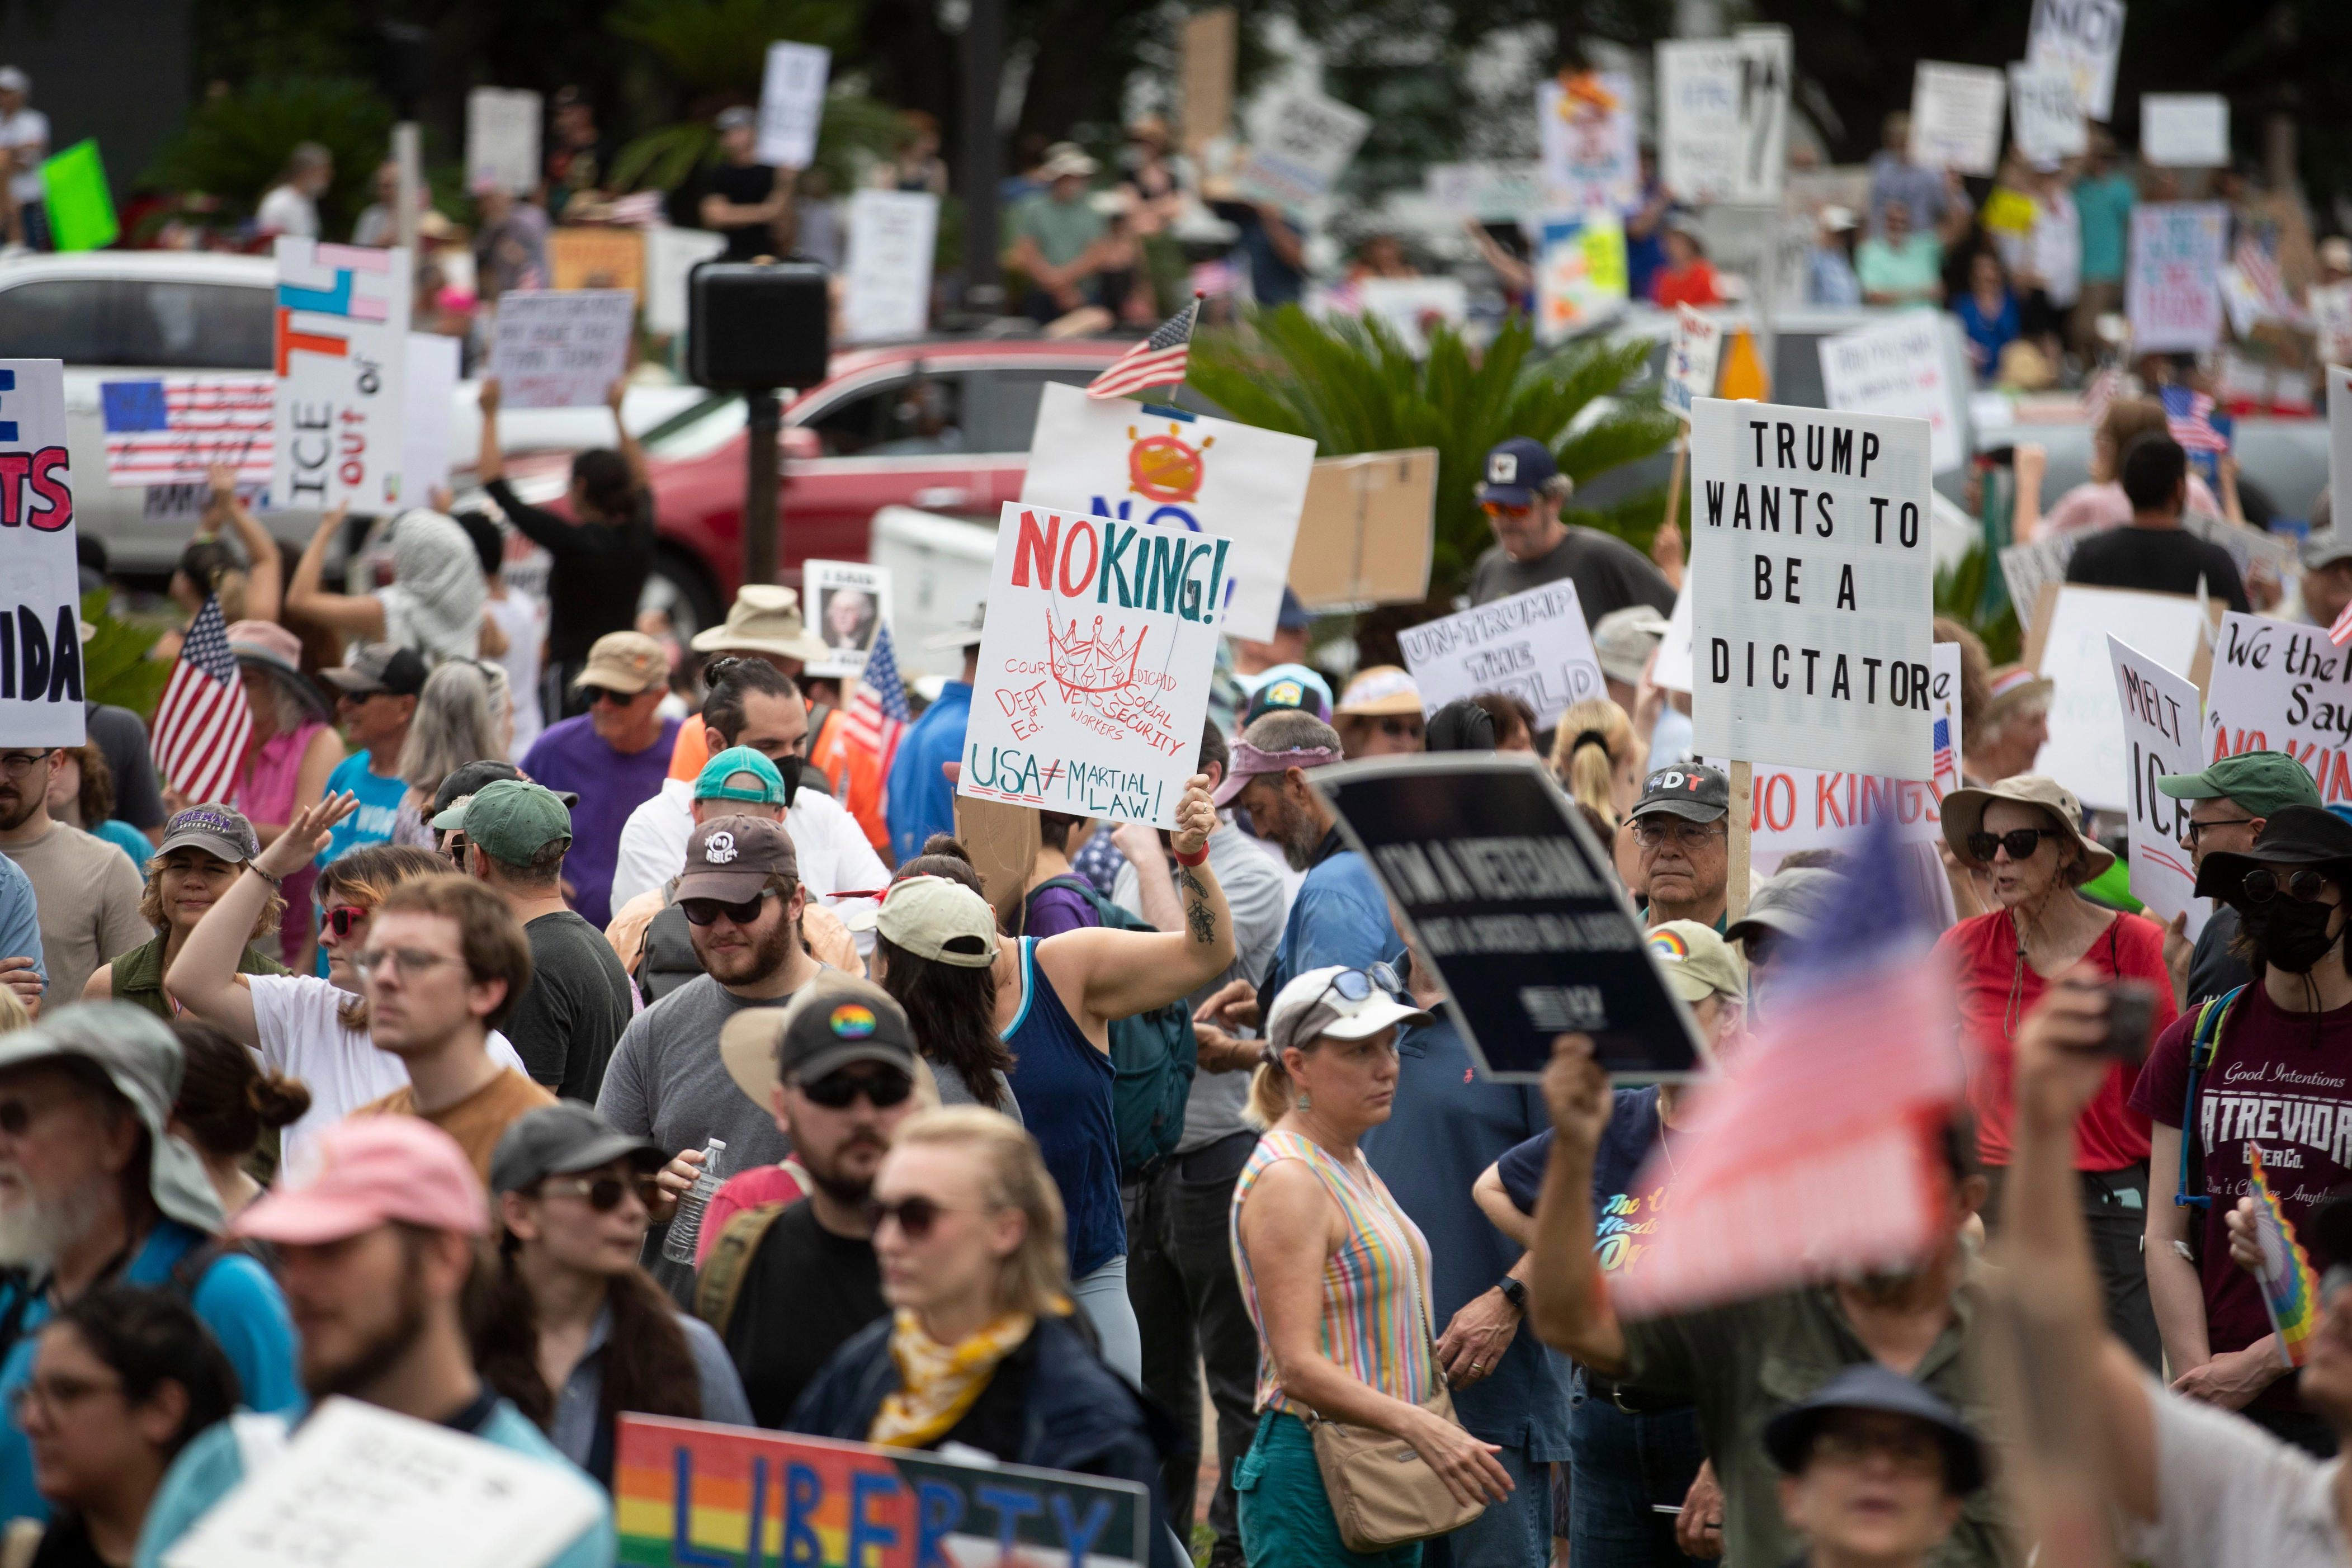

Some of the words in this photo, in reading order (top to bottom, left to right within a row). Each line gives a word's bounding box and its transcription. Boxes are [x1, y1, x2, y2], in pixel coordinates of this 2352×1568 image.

[291, 400, 331, 504] ICE
[1750, 421, 1879, 478] TRUMP
[1706, 480, 1833, 537] WANTS
[1870, 497, 1918, 548] TO
[1012, 511, 1098, 597] NO
[1097, 522, 1230, 624] KING!
[1755, 554, 1802, 604] BE
[1837, 564, 1855, 611] A
[1402, 587, 1571, 666] UN-TRUMP
[1464, 641, 1536, 682] THE
[2228, 622, 2273, 670] We
[2284, 633, 2337, 681] the
[1059, 682, 1103, 707] VETS
[1712, 637, 1930, 711] DICTATOR
[995, 680, 1046, 717] DEPT
[1029, 706, 1038, 717] of
[1114, 684, 1172, 729] SOCIAL
[2121, 663, 2181, 747] MELT
[2286, 683, 2352, 749] Say
[1011, 717, 1043, 740] Ed.
[1071, 707, 1125, 740] WORKERS
[1103, 702, 1186, 756] SECURITY
[972, 743, 1041, 796] USA
[1068, 759, 1150, 801] MARTIAL
[1649, 771, 1704, 792] FDT
[177, 811, 232, 832] FURMAN
[1090, 780, 1162, 823] LAW!
[2223, 1061, 2269, 1084] Good
[2267, 1062, 2347, 1088] Intentions
[2201, 1096, 2352, 1169] ATREVIDA
[2242, 1142, 2284, 1167] BER
[1602, 1193, 1640, 1215] The
[2284, 1184, 2343, 1207] Anythin
[1596, 1216, 1660, 1237] Needs
